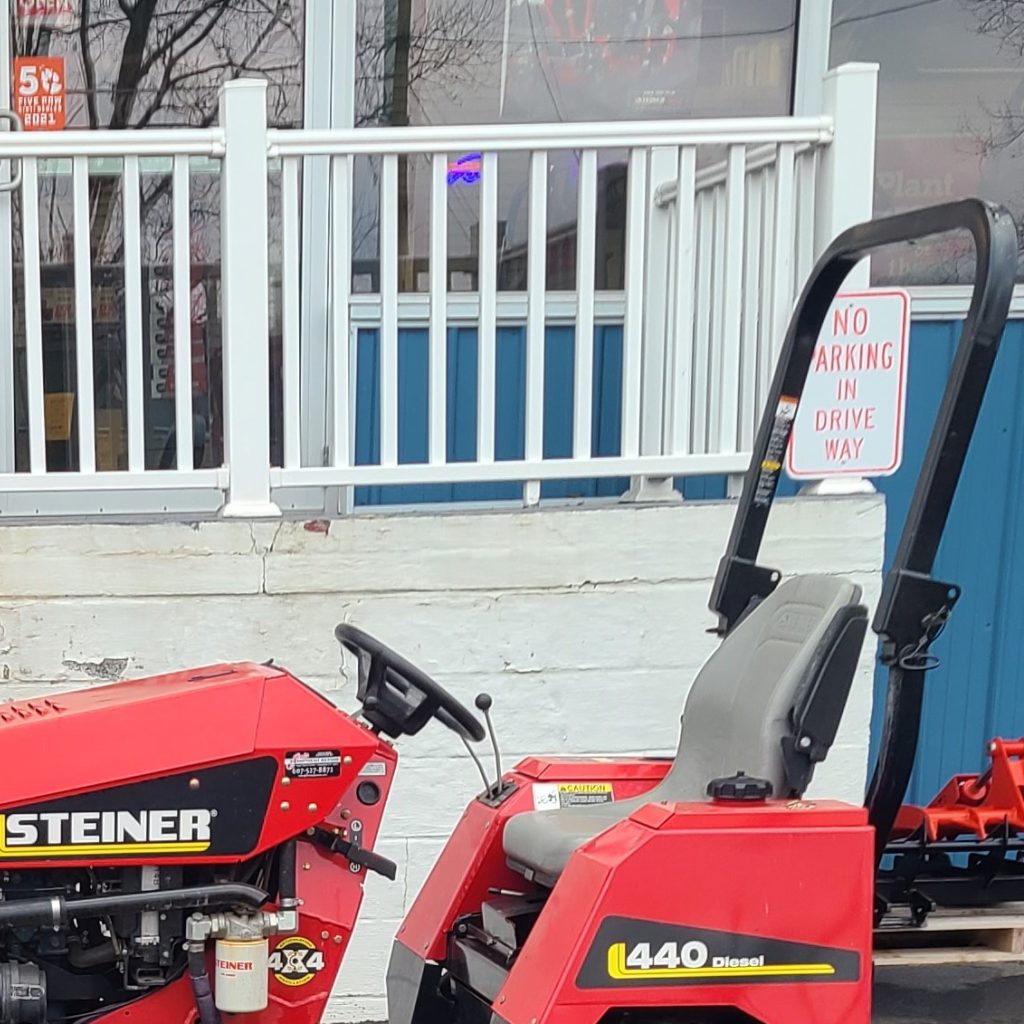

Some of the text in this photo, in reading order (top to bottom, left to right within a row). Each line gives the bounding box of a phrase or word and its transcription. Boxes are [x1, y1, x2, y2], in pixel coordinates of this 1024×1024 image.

[24, 113, 56, 126] 2021
[833, 307, 869, 337] NO
[811, 342, 894, 373] ARKING
[837, 378, 857, 401] IN
[815, 407, 876, 432] DRIVE
[824, 437, 864, 462] WAY
[6, 809, 212, 845] STEINER
[215, 959, 253, 970] TEINER
[627, 941, 765, 969] 440 Diesel
